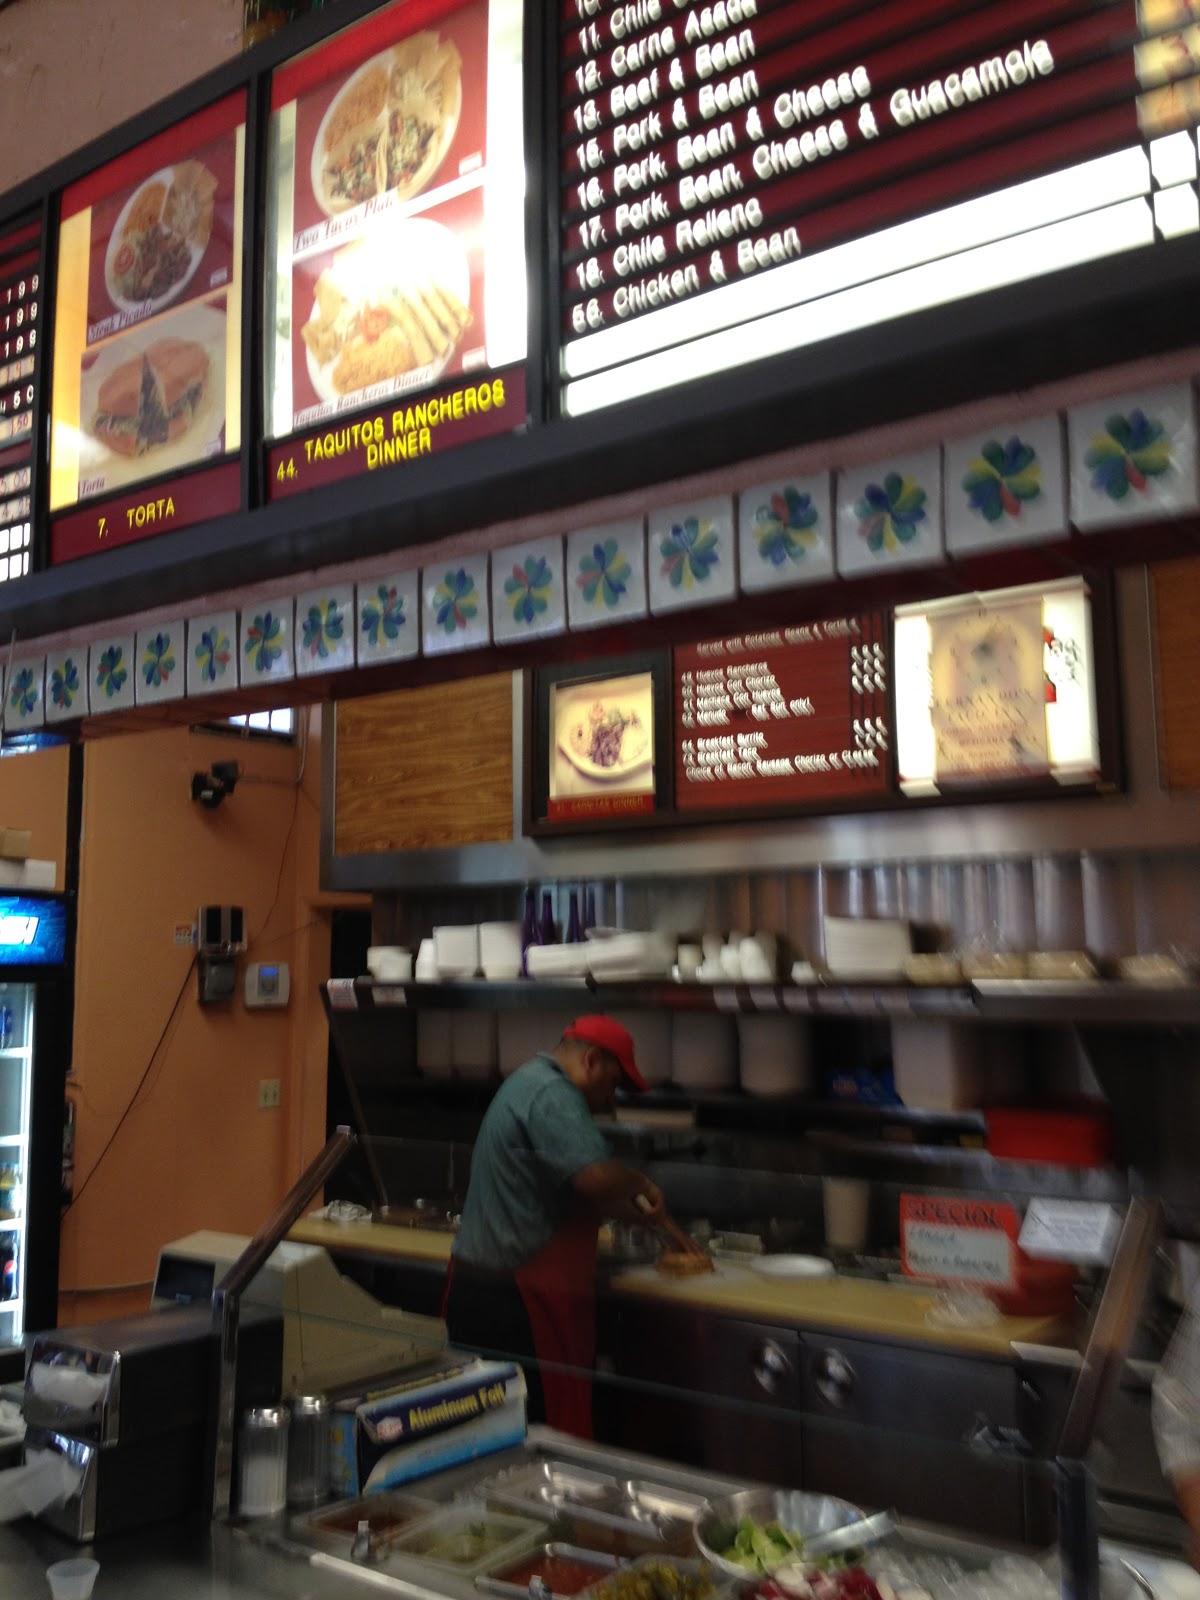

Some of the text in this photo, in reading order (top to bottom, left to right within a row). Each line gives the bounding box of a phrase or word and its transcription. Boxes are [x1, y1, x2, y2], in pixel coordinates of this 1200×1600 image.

[610, 0, 662, 39] Chile
[611, 26, 676, 77] Carne
[610, 68, 660, 118] Beef
[669, 57, 686, 91] &
[695, 28, 756, 79] Bean
[613, 110, 664, 157] Pork
[672, 97, 689, 131] &
[698, 69, 760, 120] Bean
[752, 119, 849, 180] Cheese
[858, 102, 879, 140] &
[889, 39, 1055, 127] Guacamole
[677, 121, 736, 170] Bean
[746, 106, 765, 141] &
[774, 66, 871, 128] Cheese
[613, 235, 667, 277] Chile
[613, 263, 700, 318] Chicken
[709, 250, 728, 283] &
[737, 226, 801, 274] Bean
[304, 416, 384, 464] TAQUITOS
[392, 378, 506, 435] RANCHEROS
[367, 427, 432, 471] DINNER
[126, 496, 175, 529] TORTA
